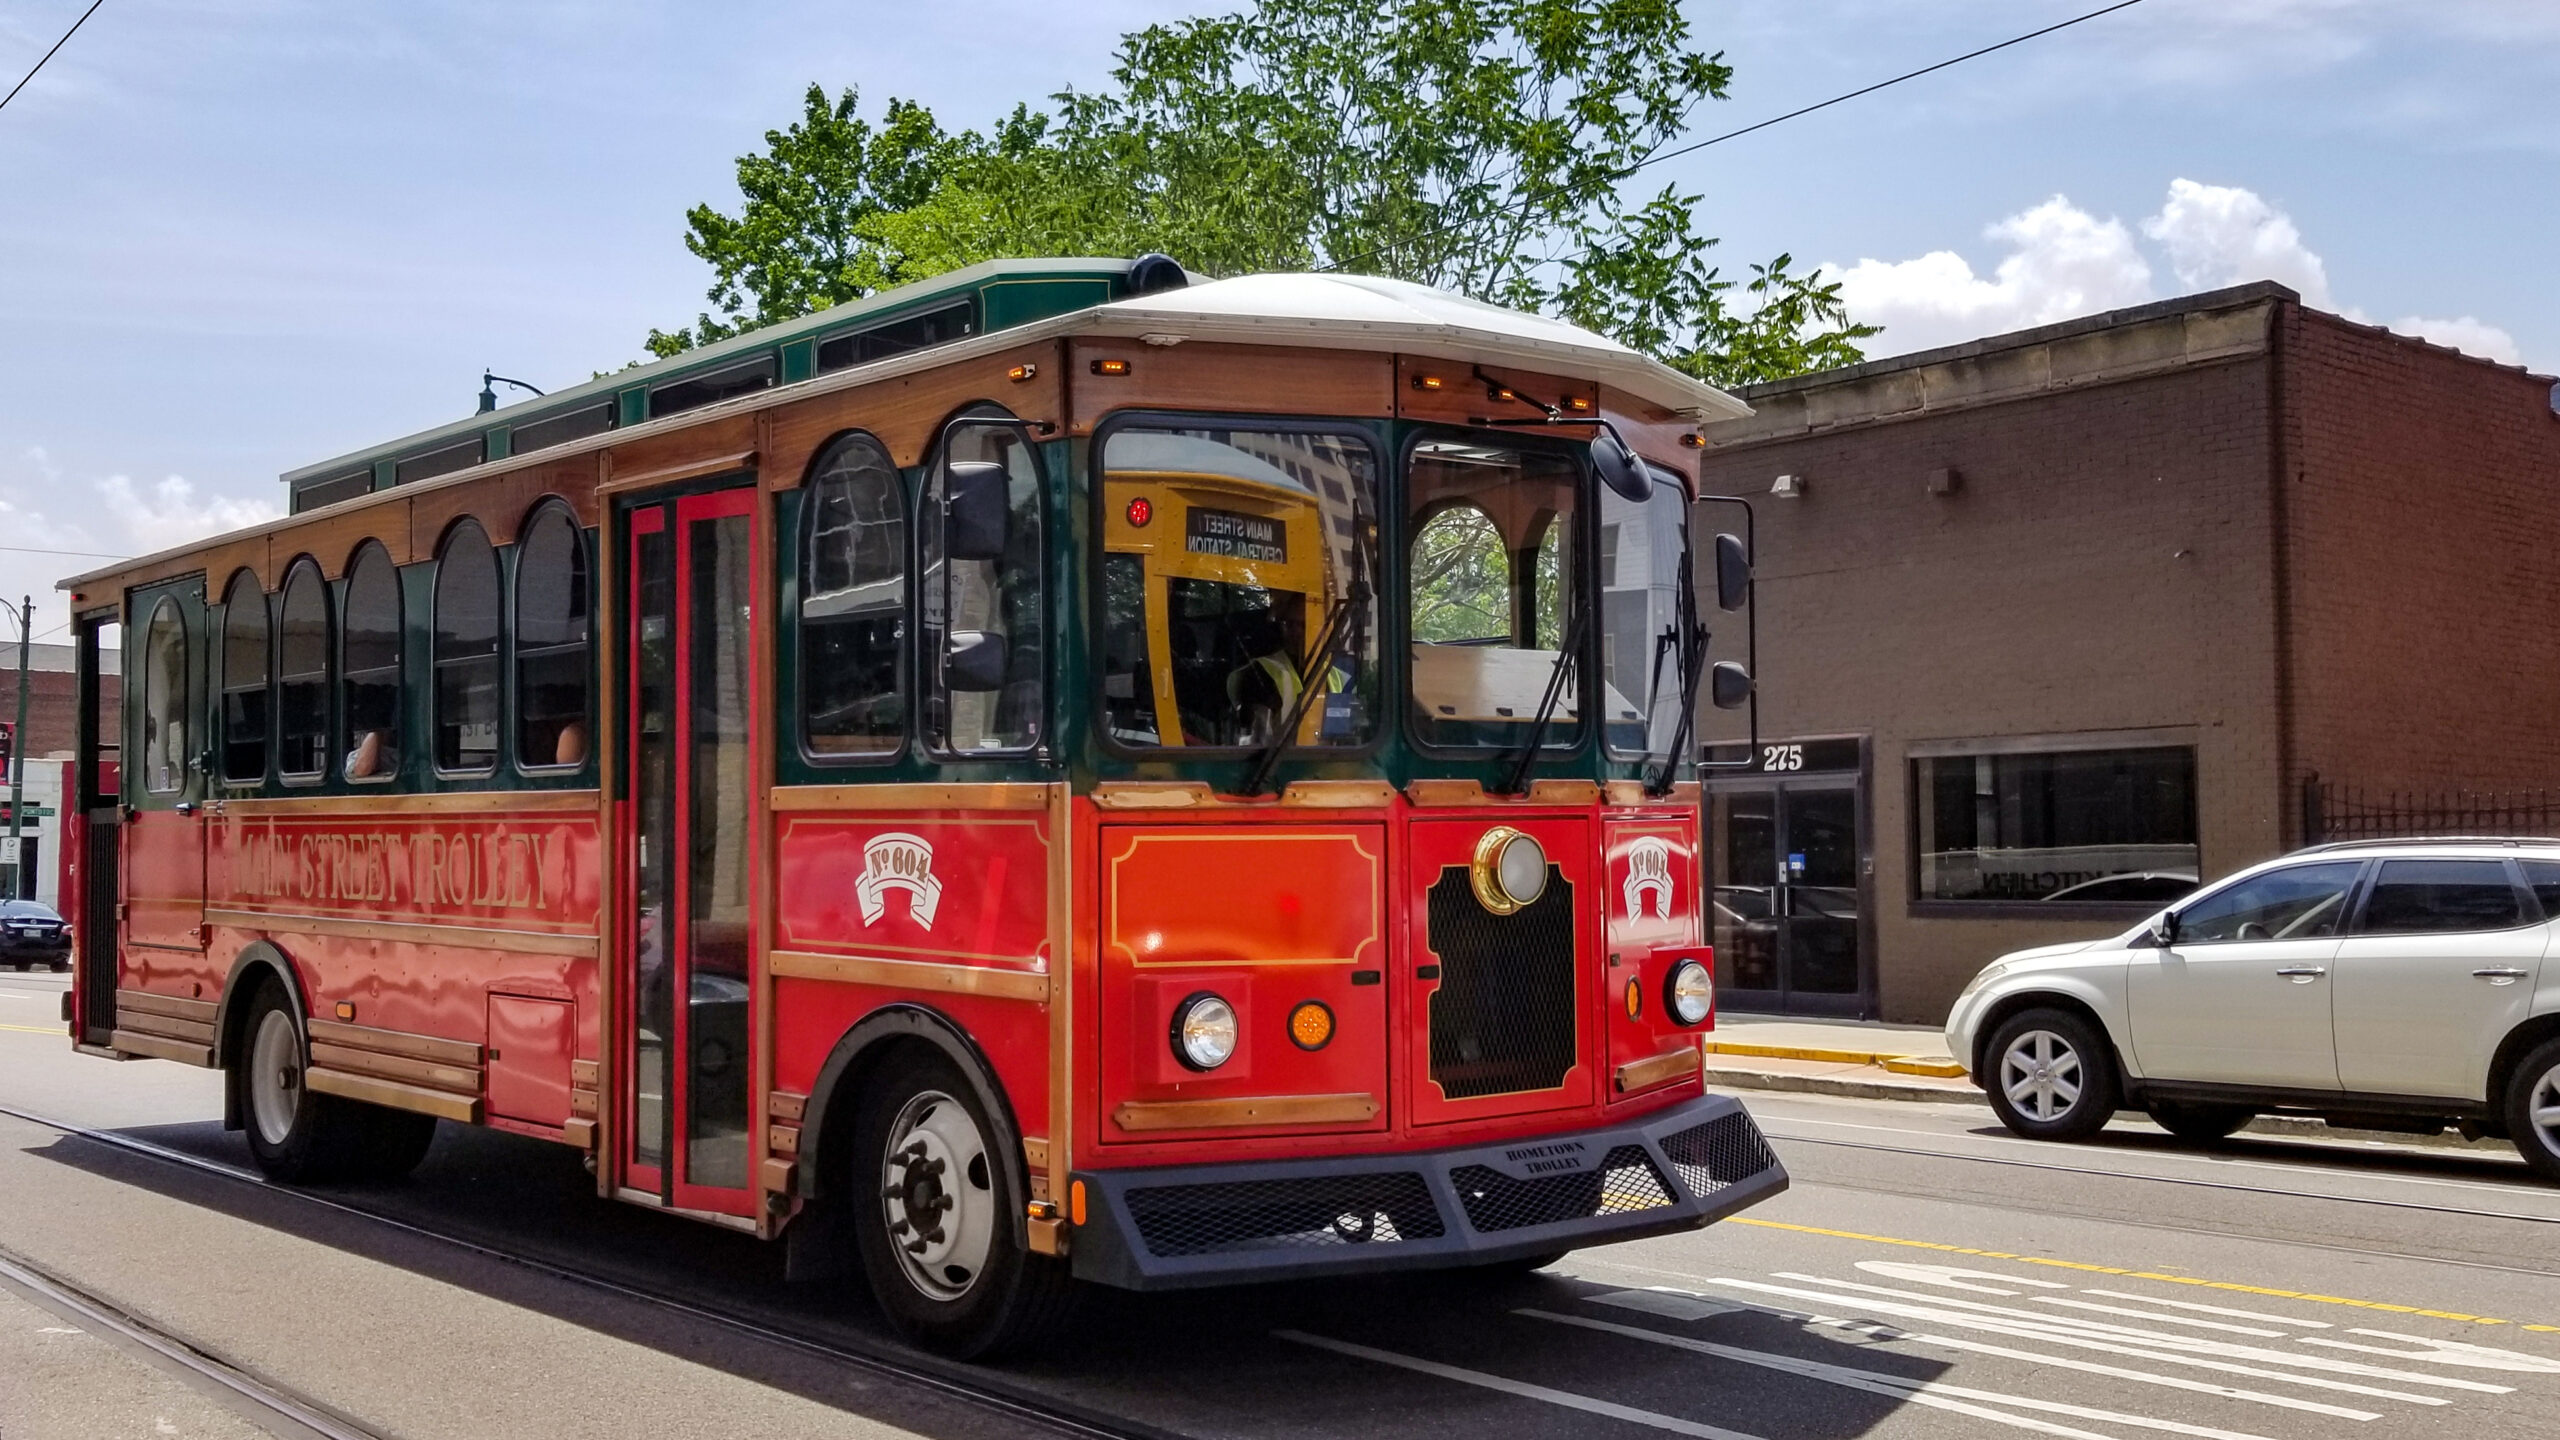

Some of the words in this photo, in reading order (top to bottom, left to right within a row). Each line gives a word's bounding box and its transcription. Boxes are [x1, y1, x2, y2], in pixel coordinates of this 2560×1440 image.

[1763, 744, 1803, 772] 275
[300, 833, 402, 902] STREET
[408, 832, 553, 910] TROLLEY
[892, 846, 929, 884] 604
[1645, 849, 1666, 881] 604
[1506, 1141, 1586, 1162] HOMETOWN
[1525, 1157, 1581, 1174] TROLLEY
